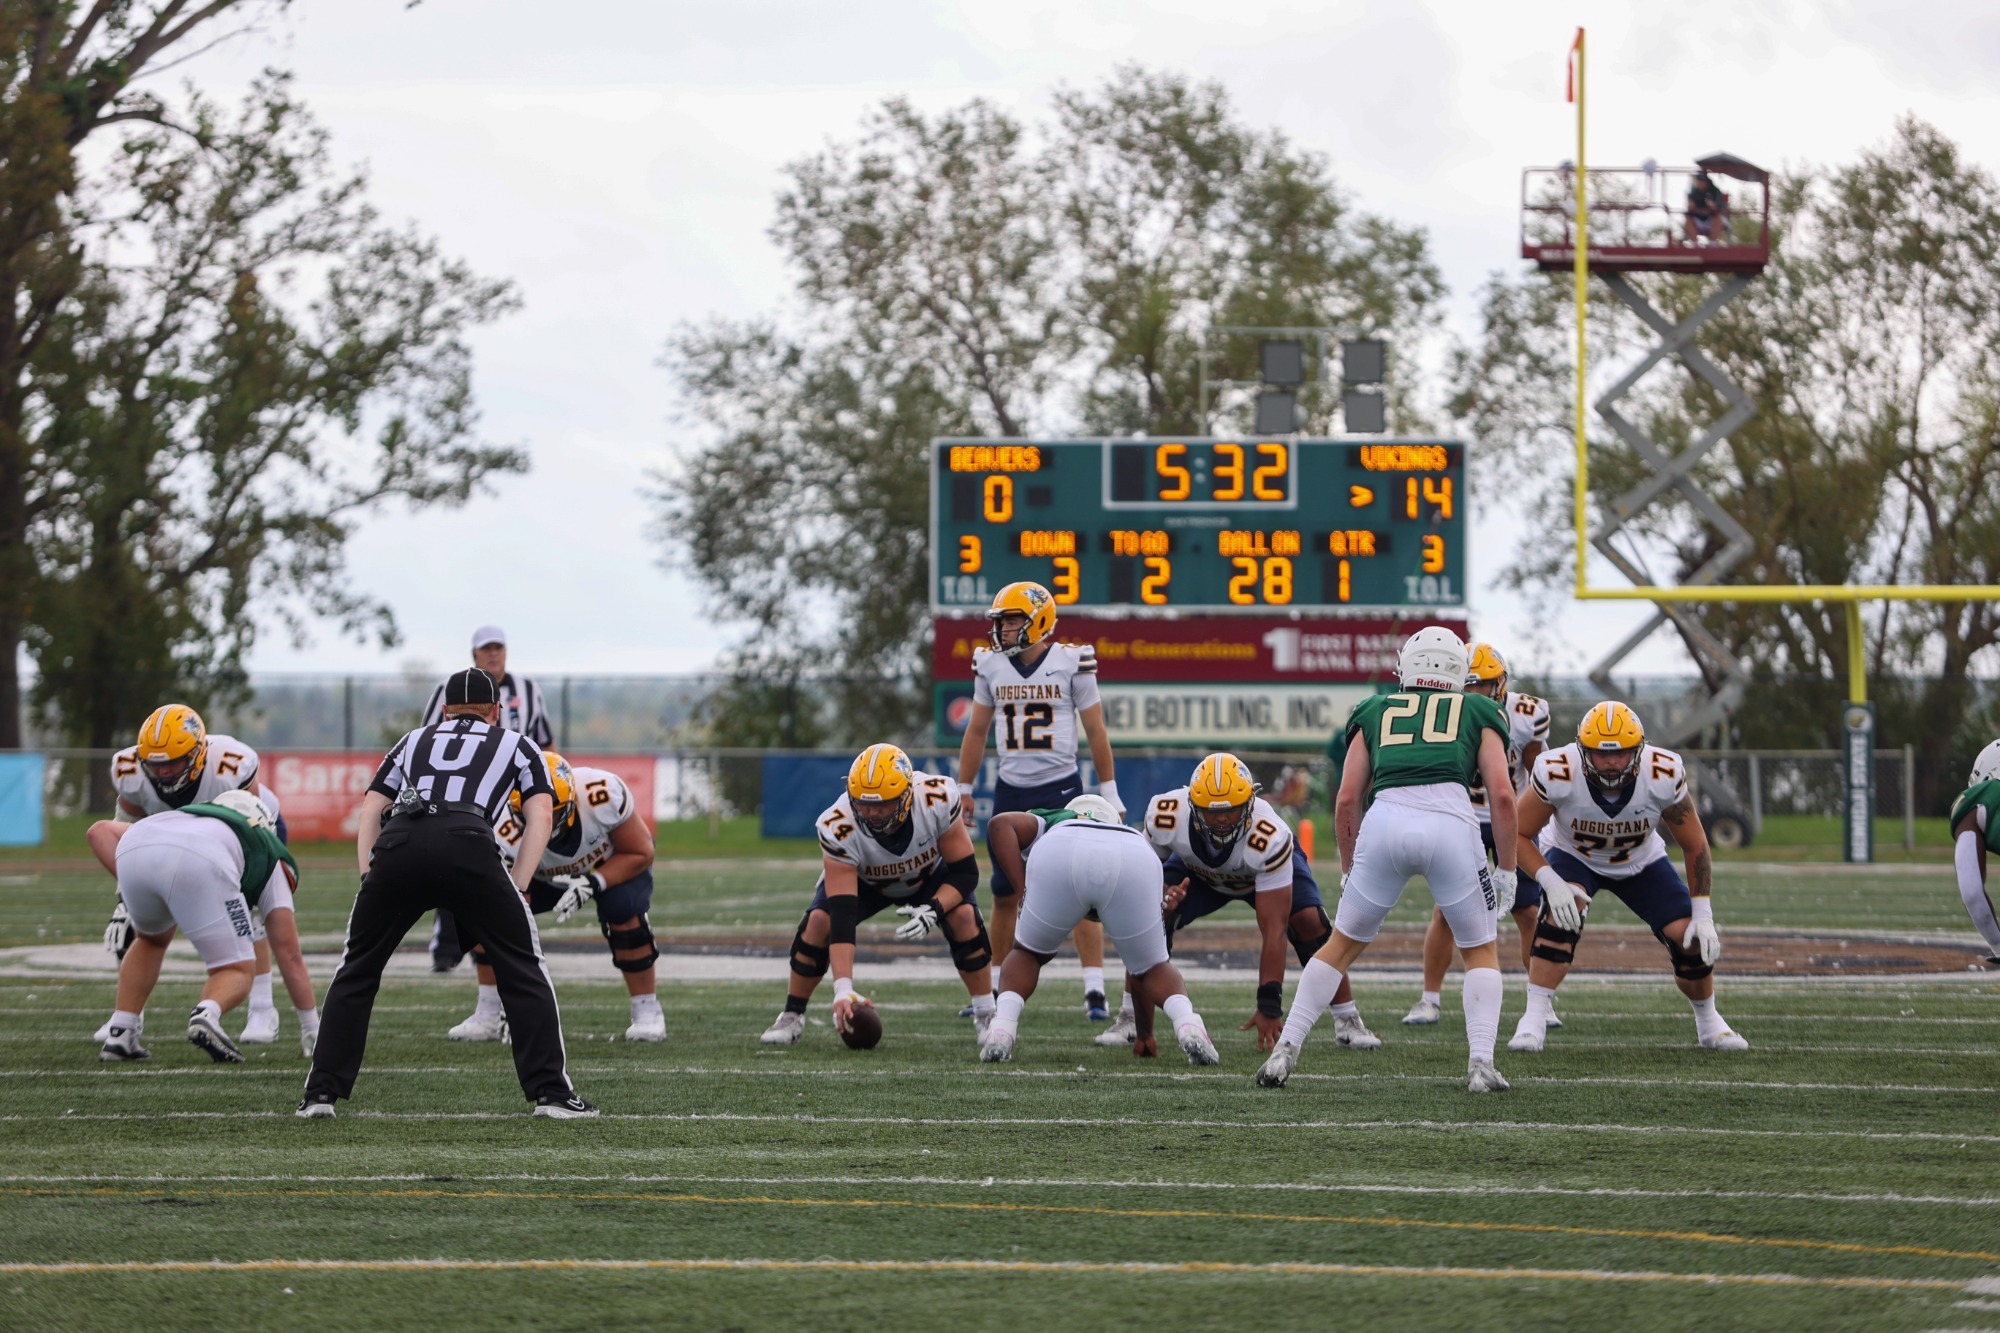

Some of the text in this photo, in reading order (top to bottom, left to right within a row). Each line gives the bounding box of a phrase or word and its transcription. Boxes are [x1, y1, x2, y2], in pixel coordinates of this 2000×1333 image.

[950, 446, 1041, 472] BEAVERS
[1156, 443, 1288, 501] 5:32
[1361, 446, 1448, 471] VIKINGS
[984, 475, 1013, 523] 0
[1407, 477, 1453, 519] 14
[959, 535, 982, 573] 3
[1020, 531, 1075, 556] DOWN
[1219, 530, 1300, 556] BALL ON
[1329, 531, 1376, 556] QTR
[1422, 535, 1444, 573] 3
[1053, 557, 1080, 604] 3
[1141, 556, 1171, 605] 2
[1229, 556, 1292, 605] 28
[1339, 559, 1350, 603] 1
[1130, 638, 1258, 660] Generations
[1301, 633, 1353, 652] FIRST
[1301, 652, 1354, 672] BANK
[994, 684, 1062, 700] AUGUSTANA
[1416, 678, 1453, 690] Riddell
[1003, 702, 1055, 750] 12
[1144, 694, 1280, 732] BOTTLING,
[1379, 693, 1465, 748] 20
[117, 752, 137, 778] 71
[217, 751, 244, 776] 71
[428, 733, 487, 771] U
[1545, 753, 1572, 781] 77
[1652, 751, 1675, 780] 77
[584, 779, 610, 807] 61
[924, 778, 948, 807] 74
[823, 808, 855, 842] 74
[1154, 798, 1178, 830] 60
[1570, 817, 1650, 836] AUGUSTANA
[498, 819, 523, 847] 61
[1247, 819, 1277, 853] 60
[1572, 831, 1647, 865] 77
[538, 841, 610, 876] AUGUSTANA
[865, 846, 938, 878] AUGUSTANA
[1477, 866, 1497, 911] BEAVERS
[225, 898, 251, 938] BEAVERS
